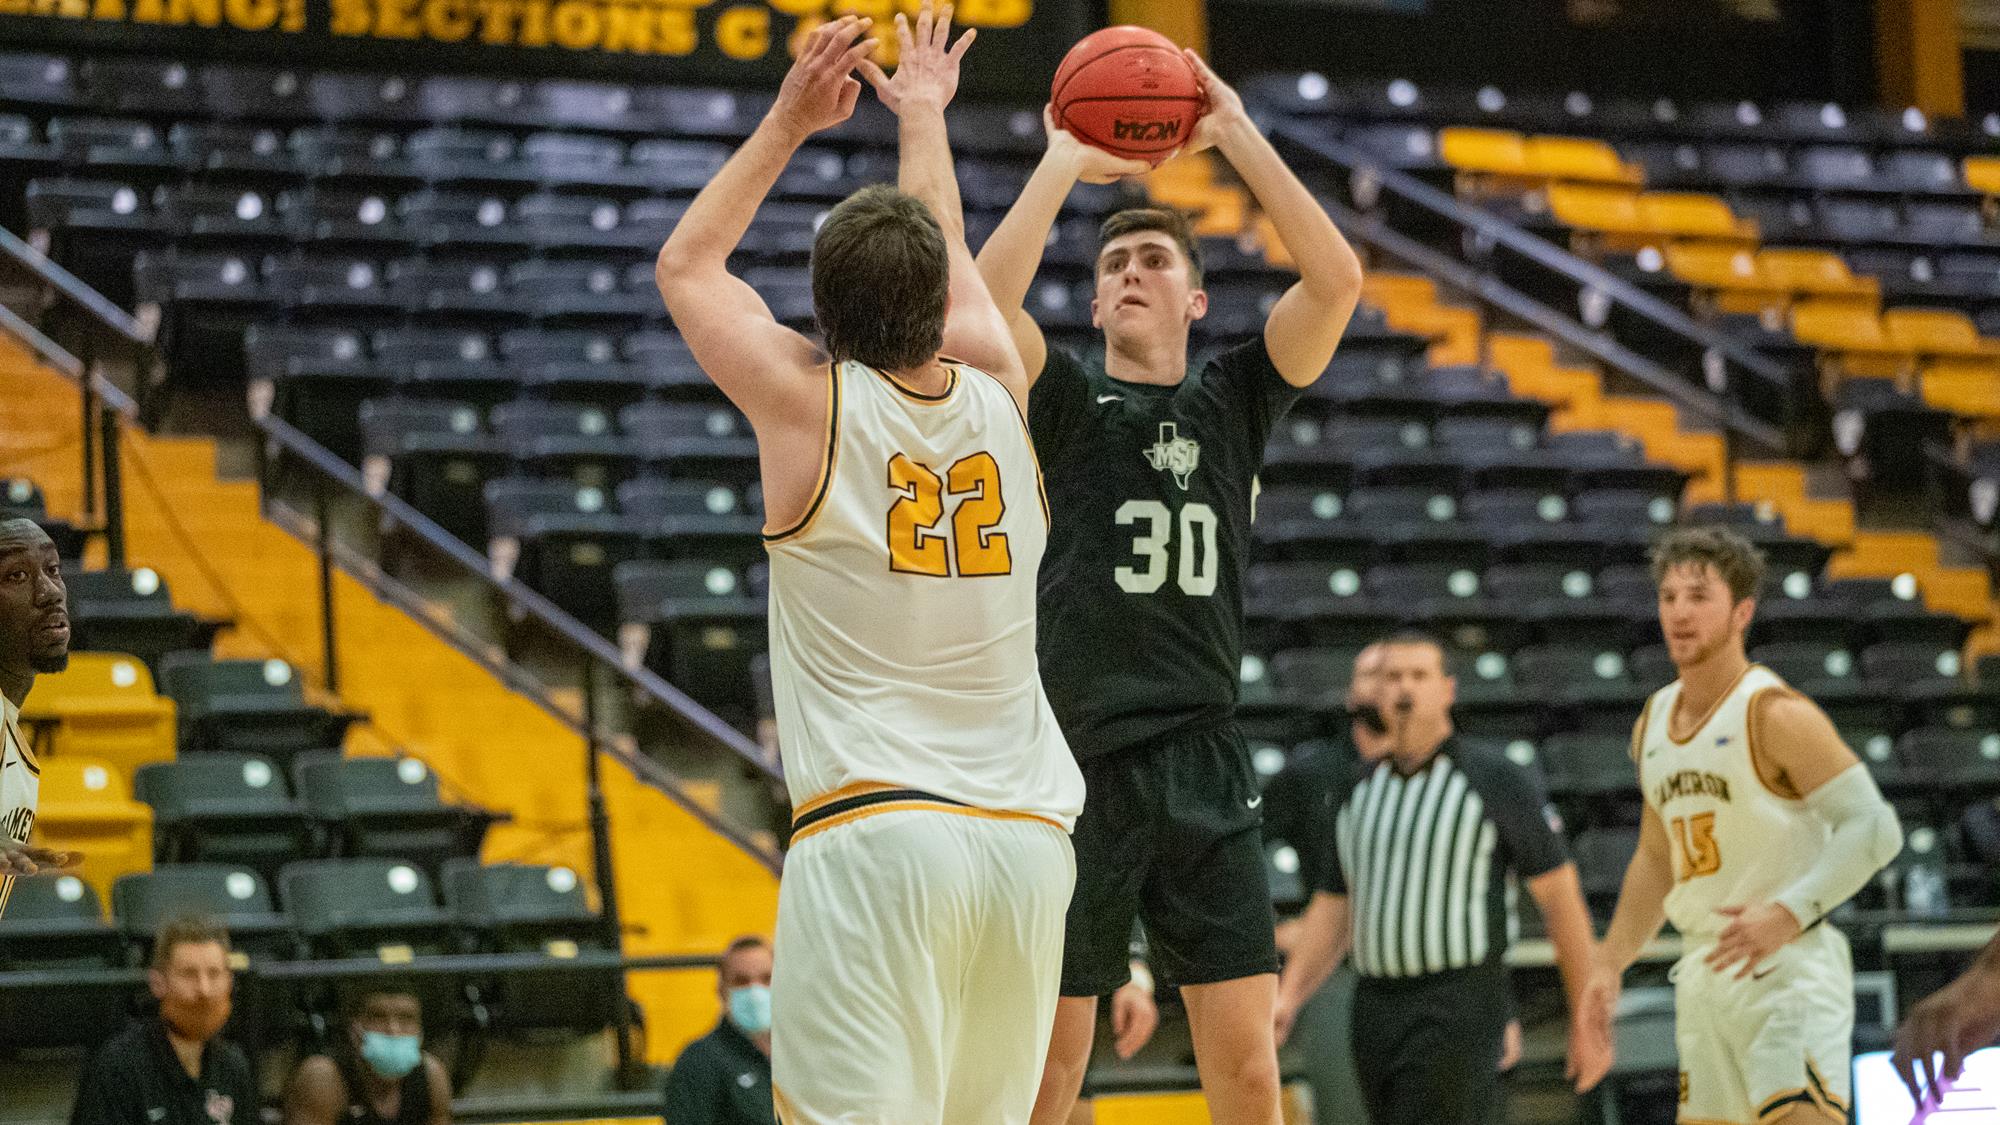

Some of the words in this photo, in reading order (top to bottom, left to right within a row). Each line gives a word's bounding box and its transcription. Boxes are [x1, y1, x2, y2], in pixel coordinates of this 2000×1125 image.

[328, 0, 697, 56] SECTIONS
[1114, 118, 1181, 141] NCAA
[1153, 438, 1200, 474] MSU
[887, 451, 1012, 578] 22
[1114, 500, 1218, 596] 30
[1671, 810, 1722, 883] 15
